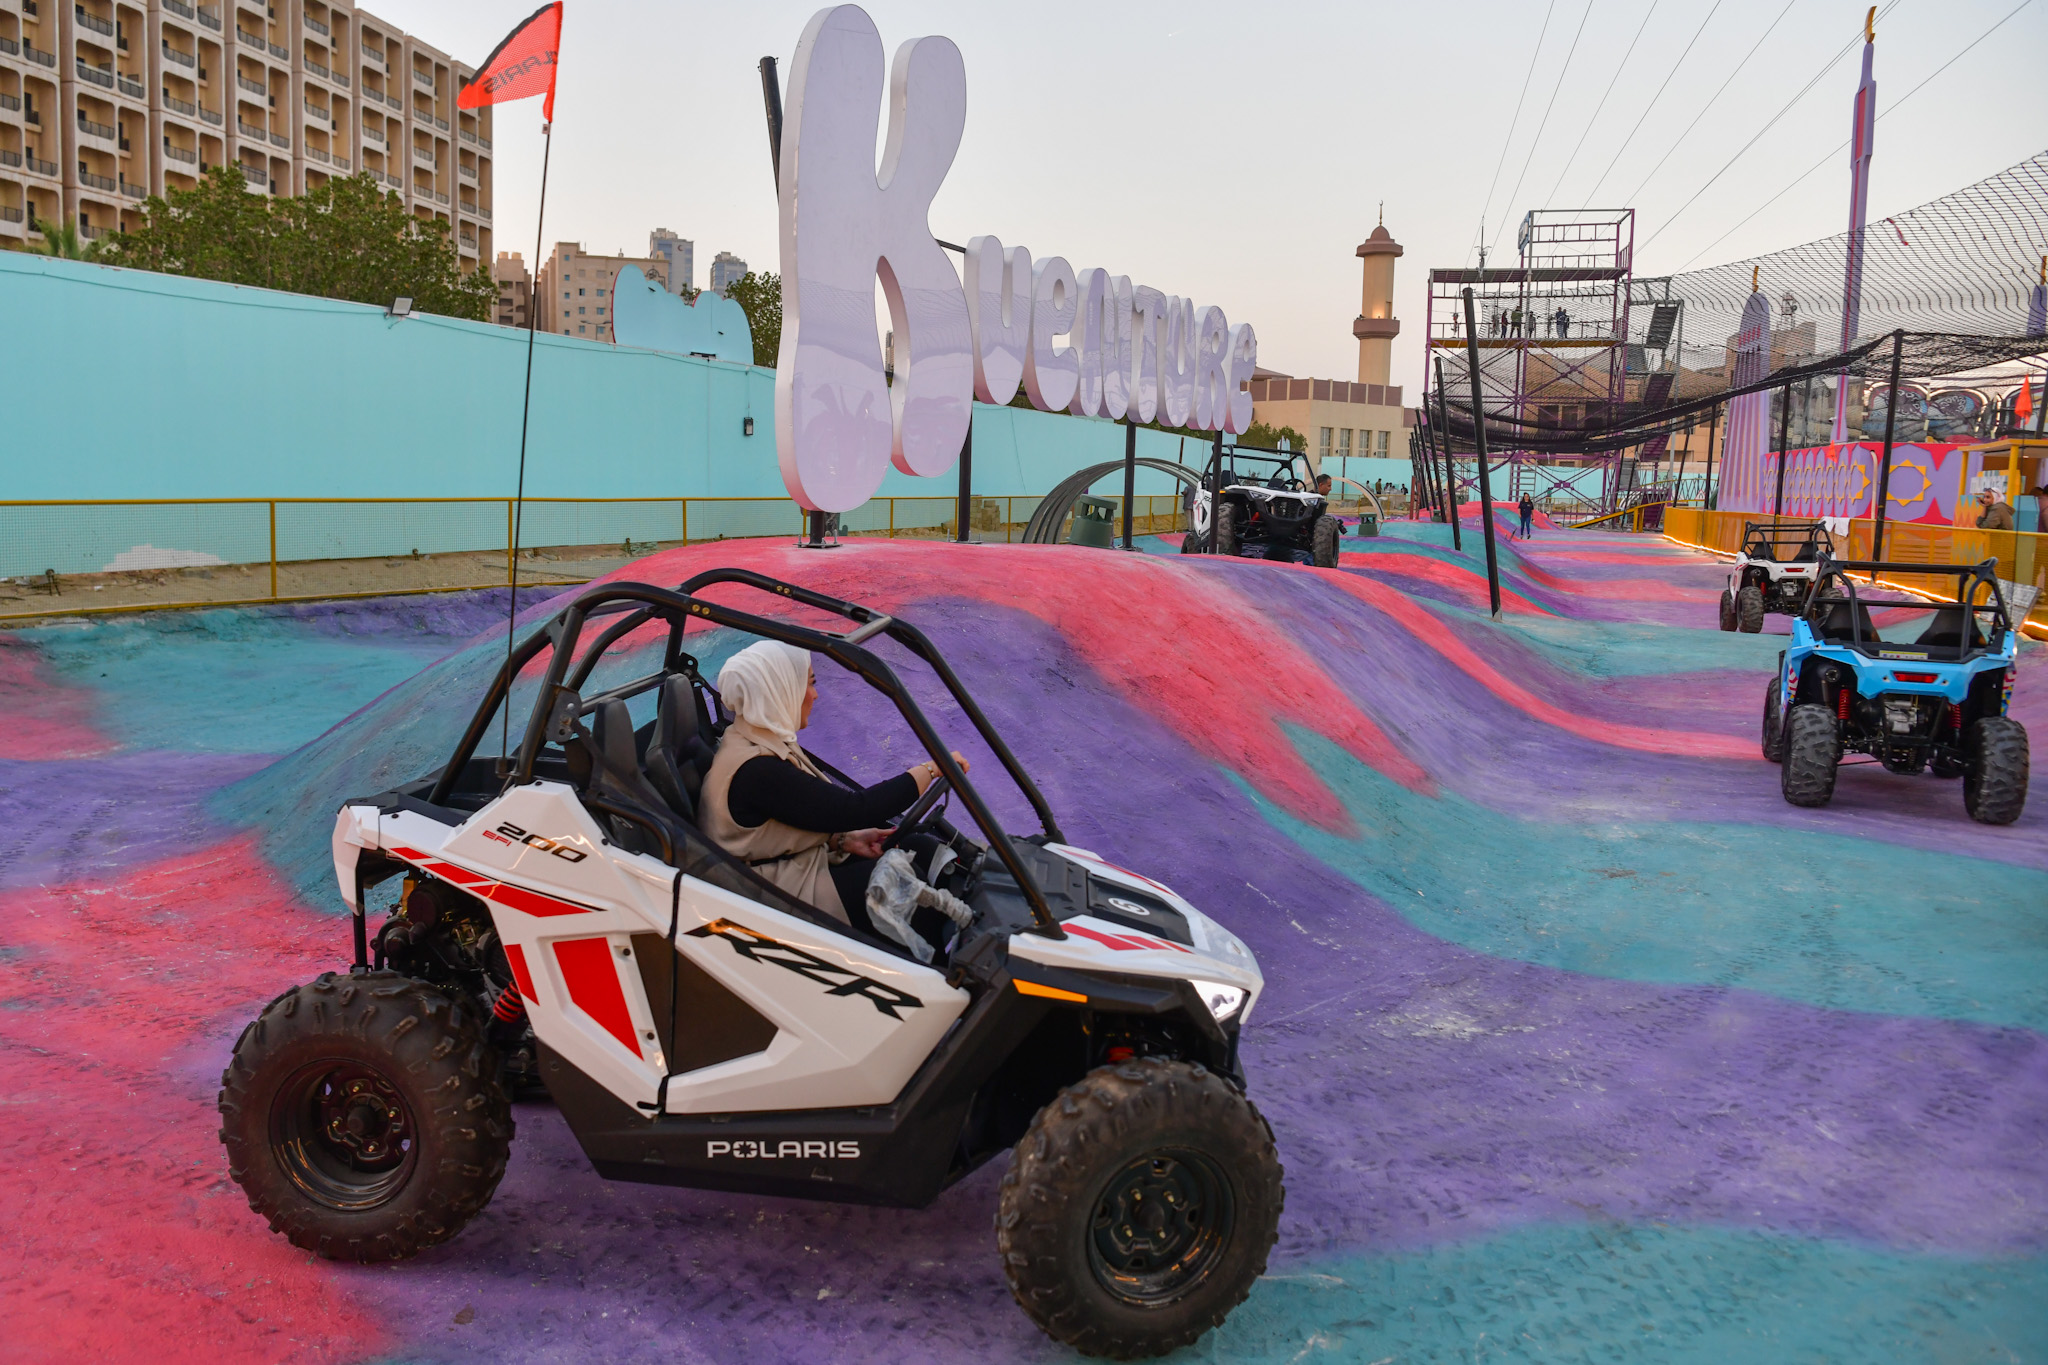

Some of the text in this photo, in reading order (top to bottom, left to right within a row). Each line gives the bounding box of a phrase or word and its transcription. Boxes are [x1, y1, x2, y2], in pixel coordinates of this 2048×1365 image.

[482, 829, 512, 847] EFI
[496, 821, 588, 863] 200
[683, 917, 925, 1022] RZR
[707, 1141, 861, 1159] POLARIS
